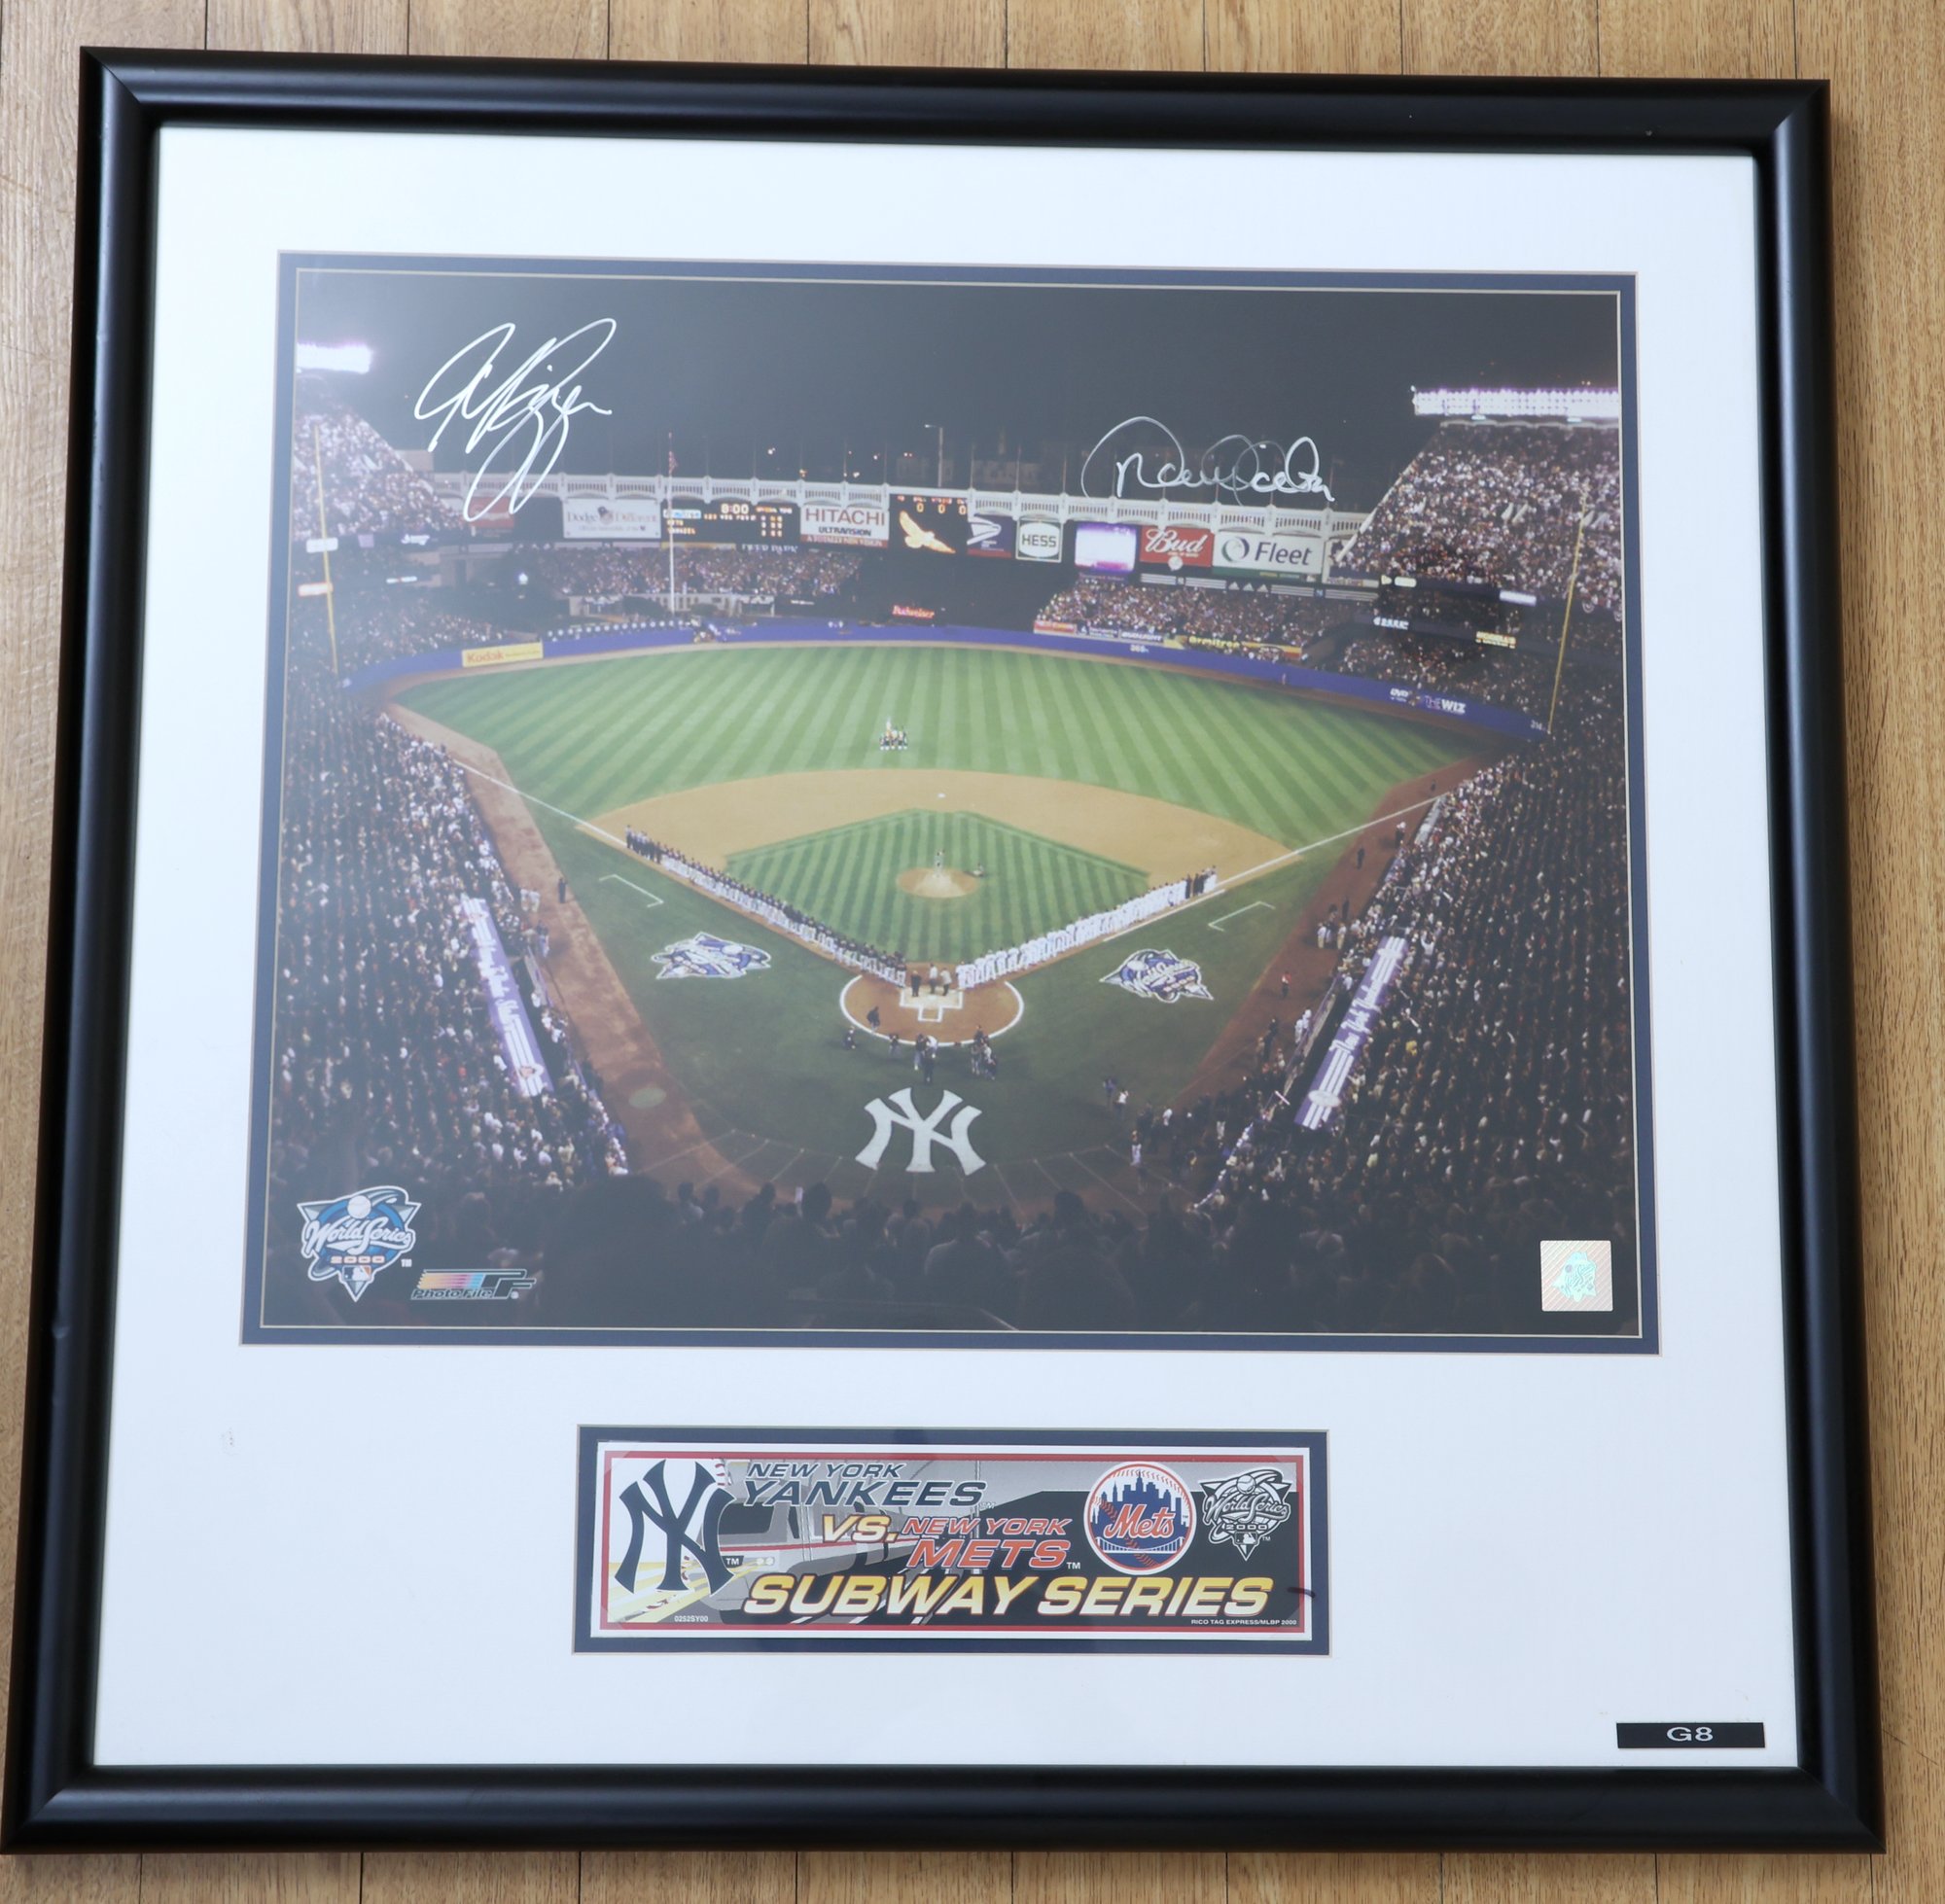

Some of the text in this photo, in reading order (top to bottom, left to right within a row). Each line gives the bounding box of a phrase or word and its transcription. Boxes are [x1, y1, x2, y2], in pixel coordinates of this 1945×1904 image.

[805, 509, 885, 526] HITACHI
[818, 526, 872, 537] ULTRAVISION
[1022, 535, 1058, 548] HESS
[1145, 529, 1208, 553] Bud
[1255, 542, 1312, 566] Fleet
[467, 650, 505, 663] Kodak
[304, 1214, 411, 1255] World Series
[410, 1288, 462, 1300] Photo
[746, 1463, 906, 1480] NEW YORK
[743, 1480, 988, 1507] YANKEES
[1205, 1490, 1289, 1524] World Series
[615, 1459, 736, 1596] NY
[822, 1514, 1073, 1544] VS. NEW YORK
[1104, 1503, 1176, 1539] Mets
[906, 1538, 1081, 1570] METS TM
[743, 1572, 1275, 1617] SUBWAY SERIES
[1666, 1726, 1714, 1742] G8
